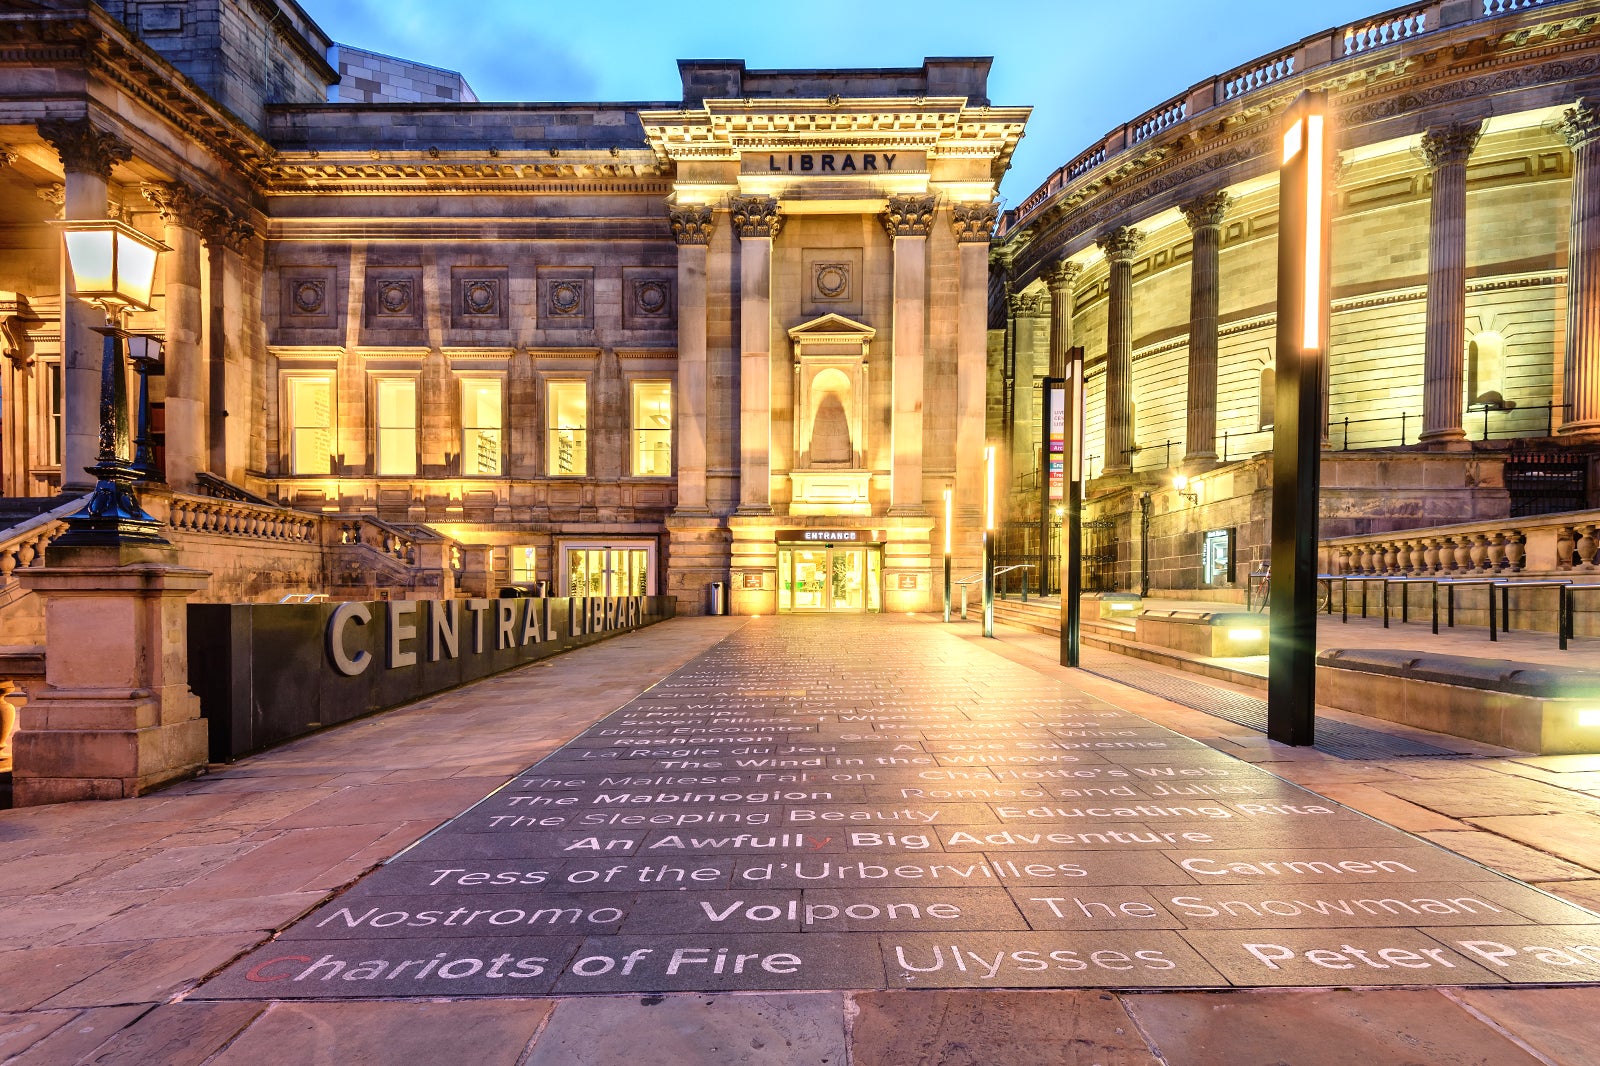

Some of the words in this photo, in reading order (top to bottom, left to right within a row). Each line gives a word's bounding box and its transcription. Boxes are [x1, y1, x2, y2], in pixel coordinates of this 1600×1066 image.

[769, 153, 897, 172] LIBRARY
[804, 532, 856, 540] ENTRANCE
[328, 597, 558, 676] CENTRAL
[568, 596, 645, 637] LIBRARY
[645, 710, 748, 718] Principe
[712, 716, 792, 724] Pillars
[840, 713, 953, 722] Wisdom
[599, 728, 666, 736] Brief
[671, 725, 814, 734] Encounter
[840, 733, 920, 741] Gone
[929, 731, 993, 739] with
[1001, 730, 1047, 738] the
[1056, 728, 1139, 738] Wind
[879, 722, 1014, 730] Reservoir
[1023, 721, 1101, 730] Dogs
[614, 735, 774, 745] Rashomon
[893, 744, 917, 752] A
[1015, 740, 1168, 751] Supreme
[582, 751, 618, 759] La
[730, 746, 770, 755] du
[779, 745, 837, 754] Jeu
[661, 761, 723, 770] The
[735, 757, 822, 768] Wind
[836, 756, 874, 767] in
[875, 755, 932, 766] the
[941, 753, 1080, 764] Willows
[521, 778, 587, 789] The
[598, 774, 741, 787] Maltese
[918, 767, 1129, 781] Charlotte's
[1134, 765, 1229, 777] Web
[507, 795, 579, 806] The
[592, 790, 833, 804] Mabinogion
[899, 786, 1044, 799] Romeo
[1060, 784, 1137, 798] and
[1151, 781, 1262, 797] Juliet
[488, 815, 566, 828] The
[578, 810, 771, 826] Sleeping
[789, 809, 940, 823] Beauty
[996, 803, 1232, 819] Educating
[1236, 801, 1335, 816] Rita
[563, 837, 635, 851] An
[648, 833, 832, 850] Awfully
[851, 831, 932, 850] Big
[946, 830, 1214, 847] Adventure
[427, 868, 550, 886] Tess
[566, 864, 628, 884] of
[637, 864, 722, 883] the
[741, 860, 1089, 883] d'Urbervilles
[1179, 858, 1418, 877] Carmen
[315, 906, 624, 928] Nostromo
[699, 900, 962, 932] Volpone
[1029, 896, 1159, 920] The
[1170, 896, 1502, 919] Snowman
[894, 944, 1177, 980] Ulysses
[1241, 942, 1457, 969] Peter
[245, 949, 550, 983] Chariots
[572, 948, 654, 977] of
[665, 947, 802, 976] Fire
